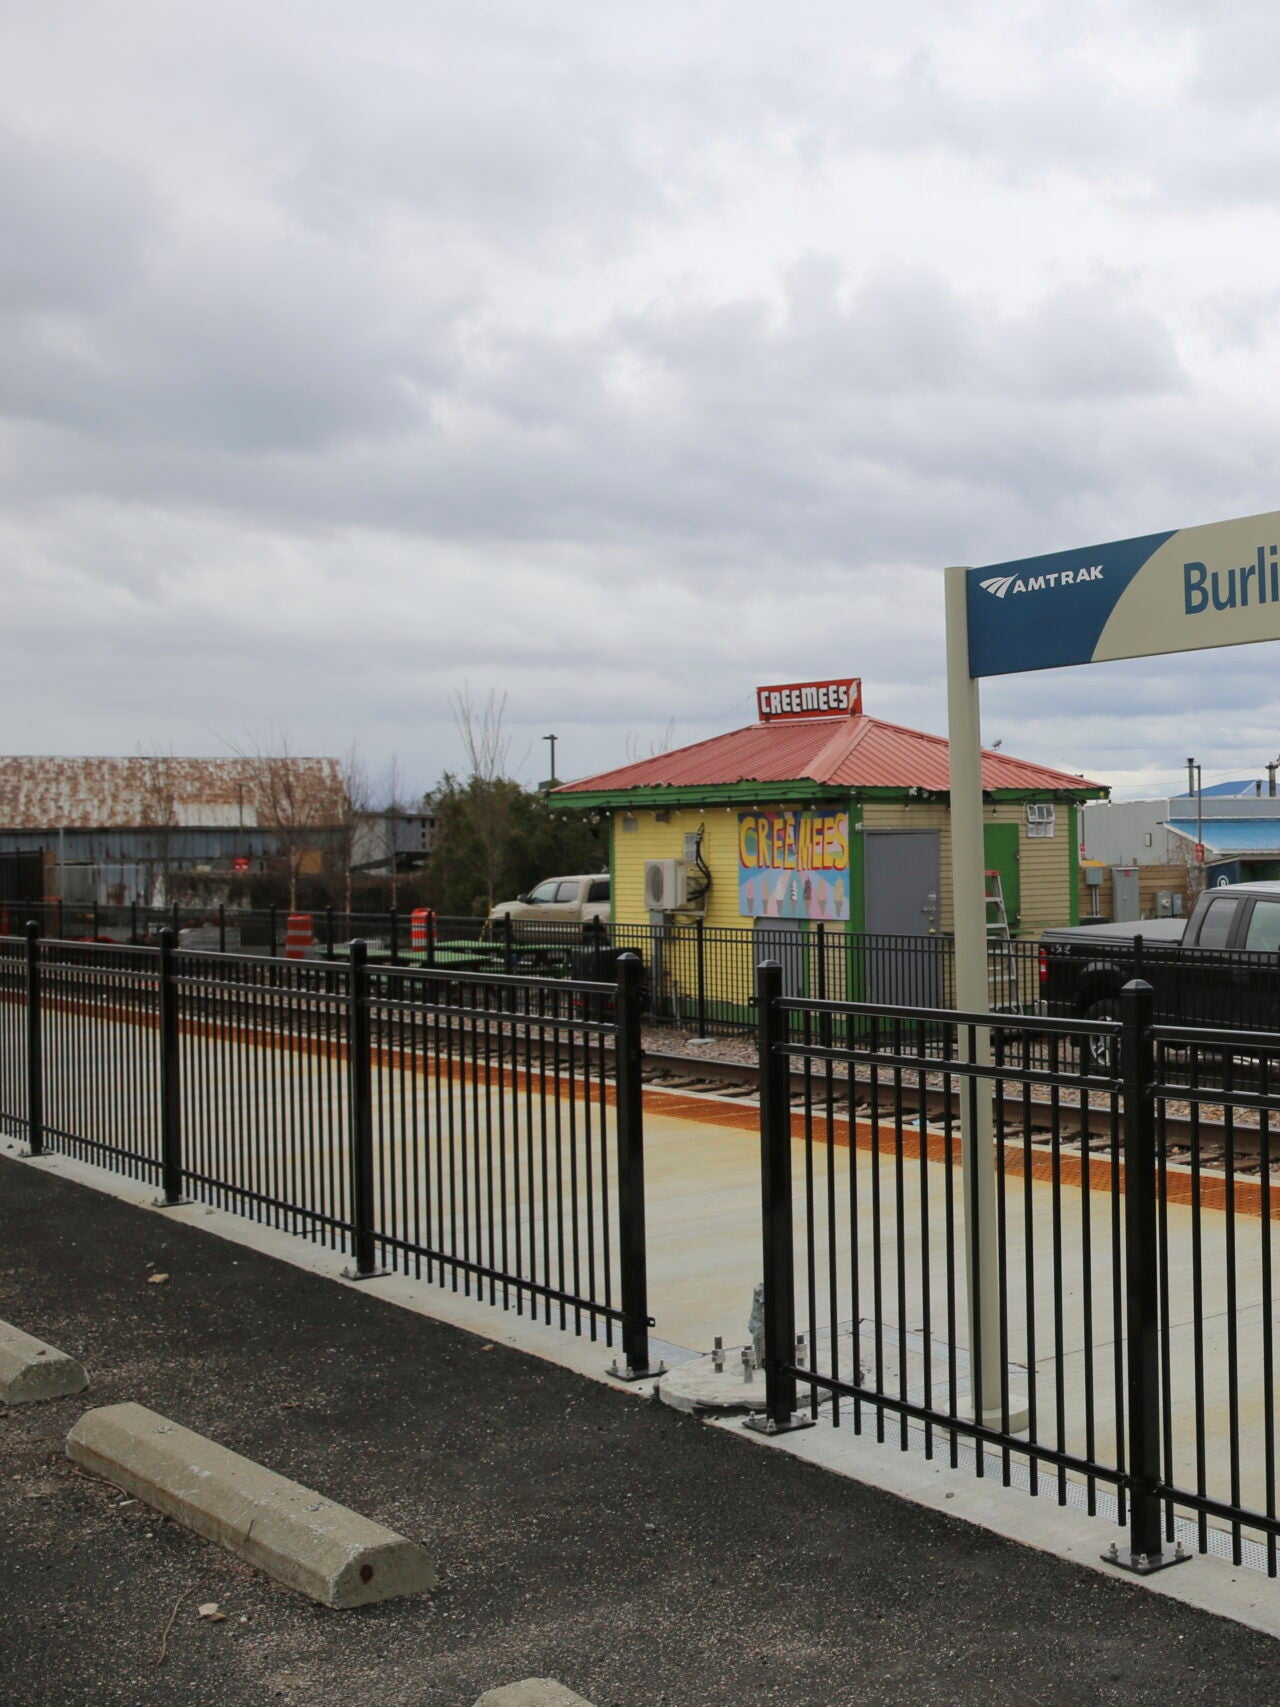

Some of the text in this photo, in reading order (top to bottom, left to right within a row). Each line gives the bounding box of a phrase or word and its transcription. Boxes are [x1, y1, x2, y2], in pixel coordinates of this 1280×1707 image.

[1012, 565, 1104, 594] AMTRAK
[760, 685, 849, 715] CREEMEES
[740, 813, 848, 872] CREEMEES
